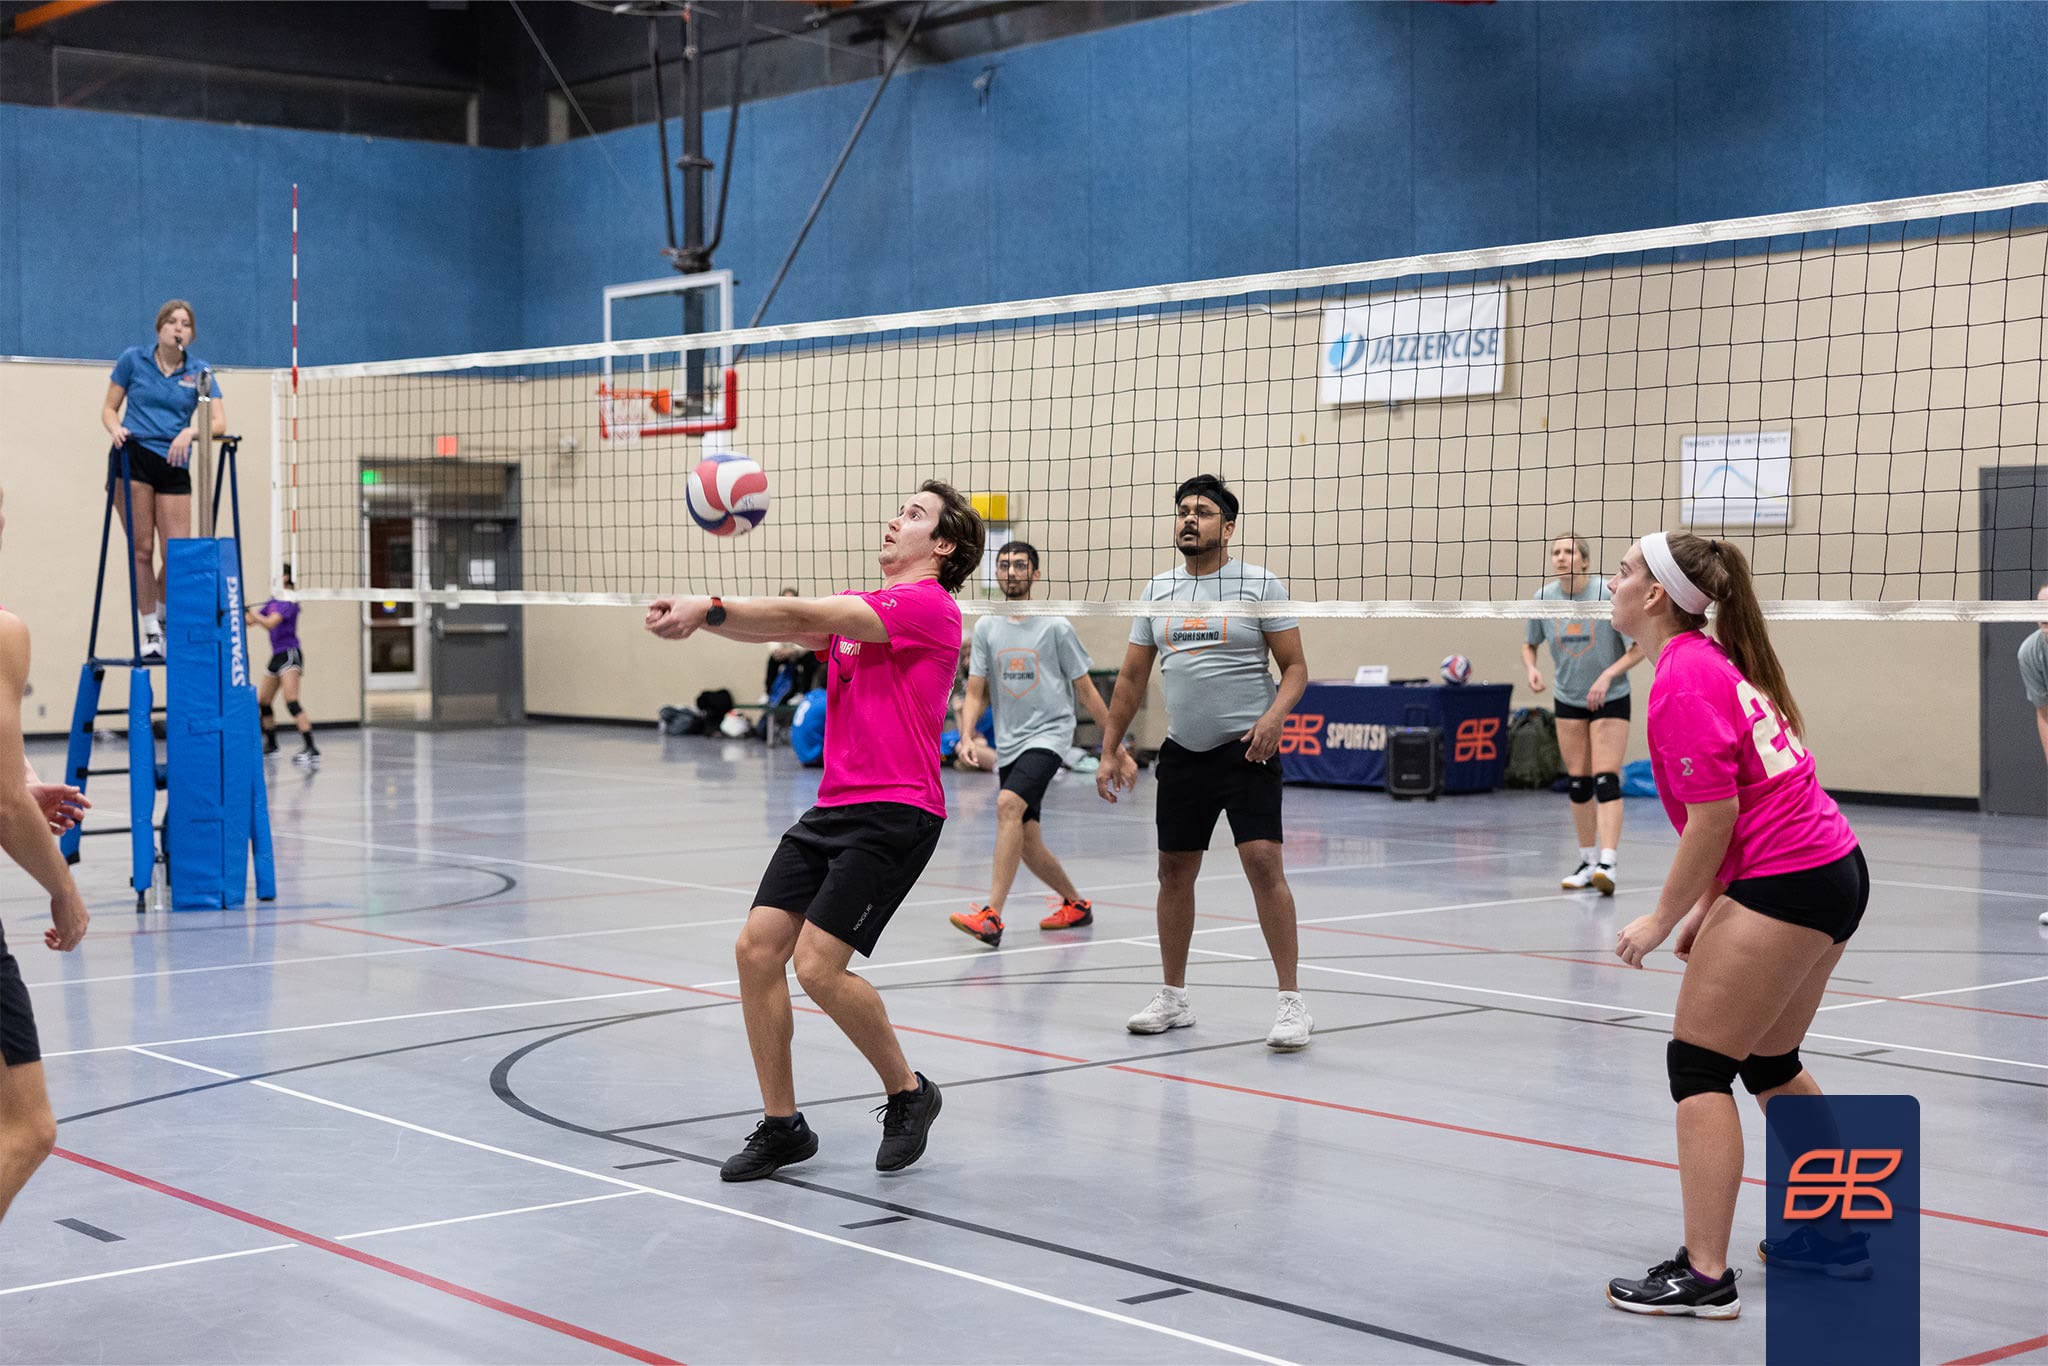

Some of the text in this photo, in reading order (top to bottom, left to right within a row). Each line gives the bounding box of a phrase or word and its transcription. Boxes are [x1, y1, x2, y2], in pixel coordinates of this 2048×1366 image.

[1370, 328, 1498, 366] JAZZERCISE
[226, 576, 246, 687] SPALDING
[1172, 631, 1220, 642] SPORTSKIND
